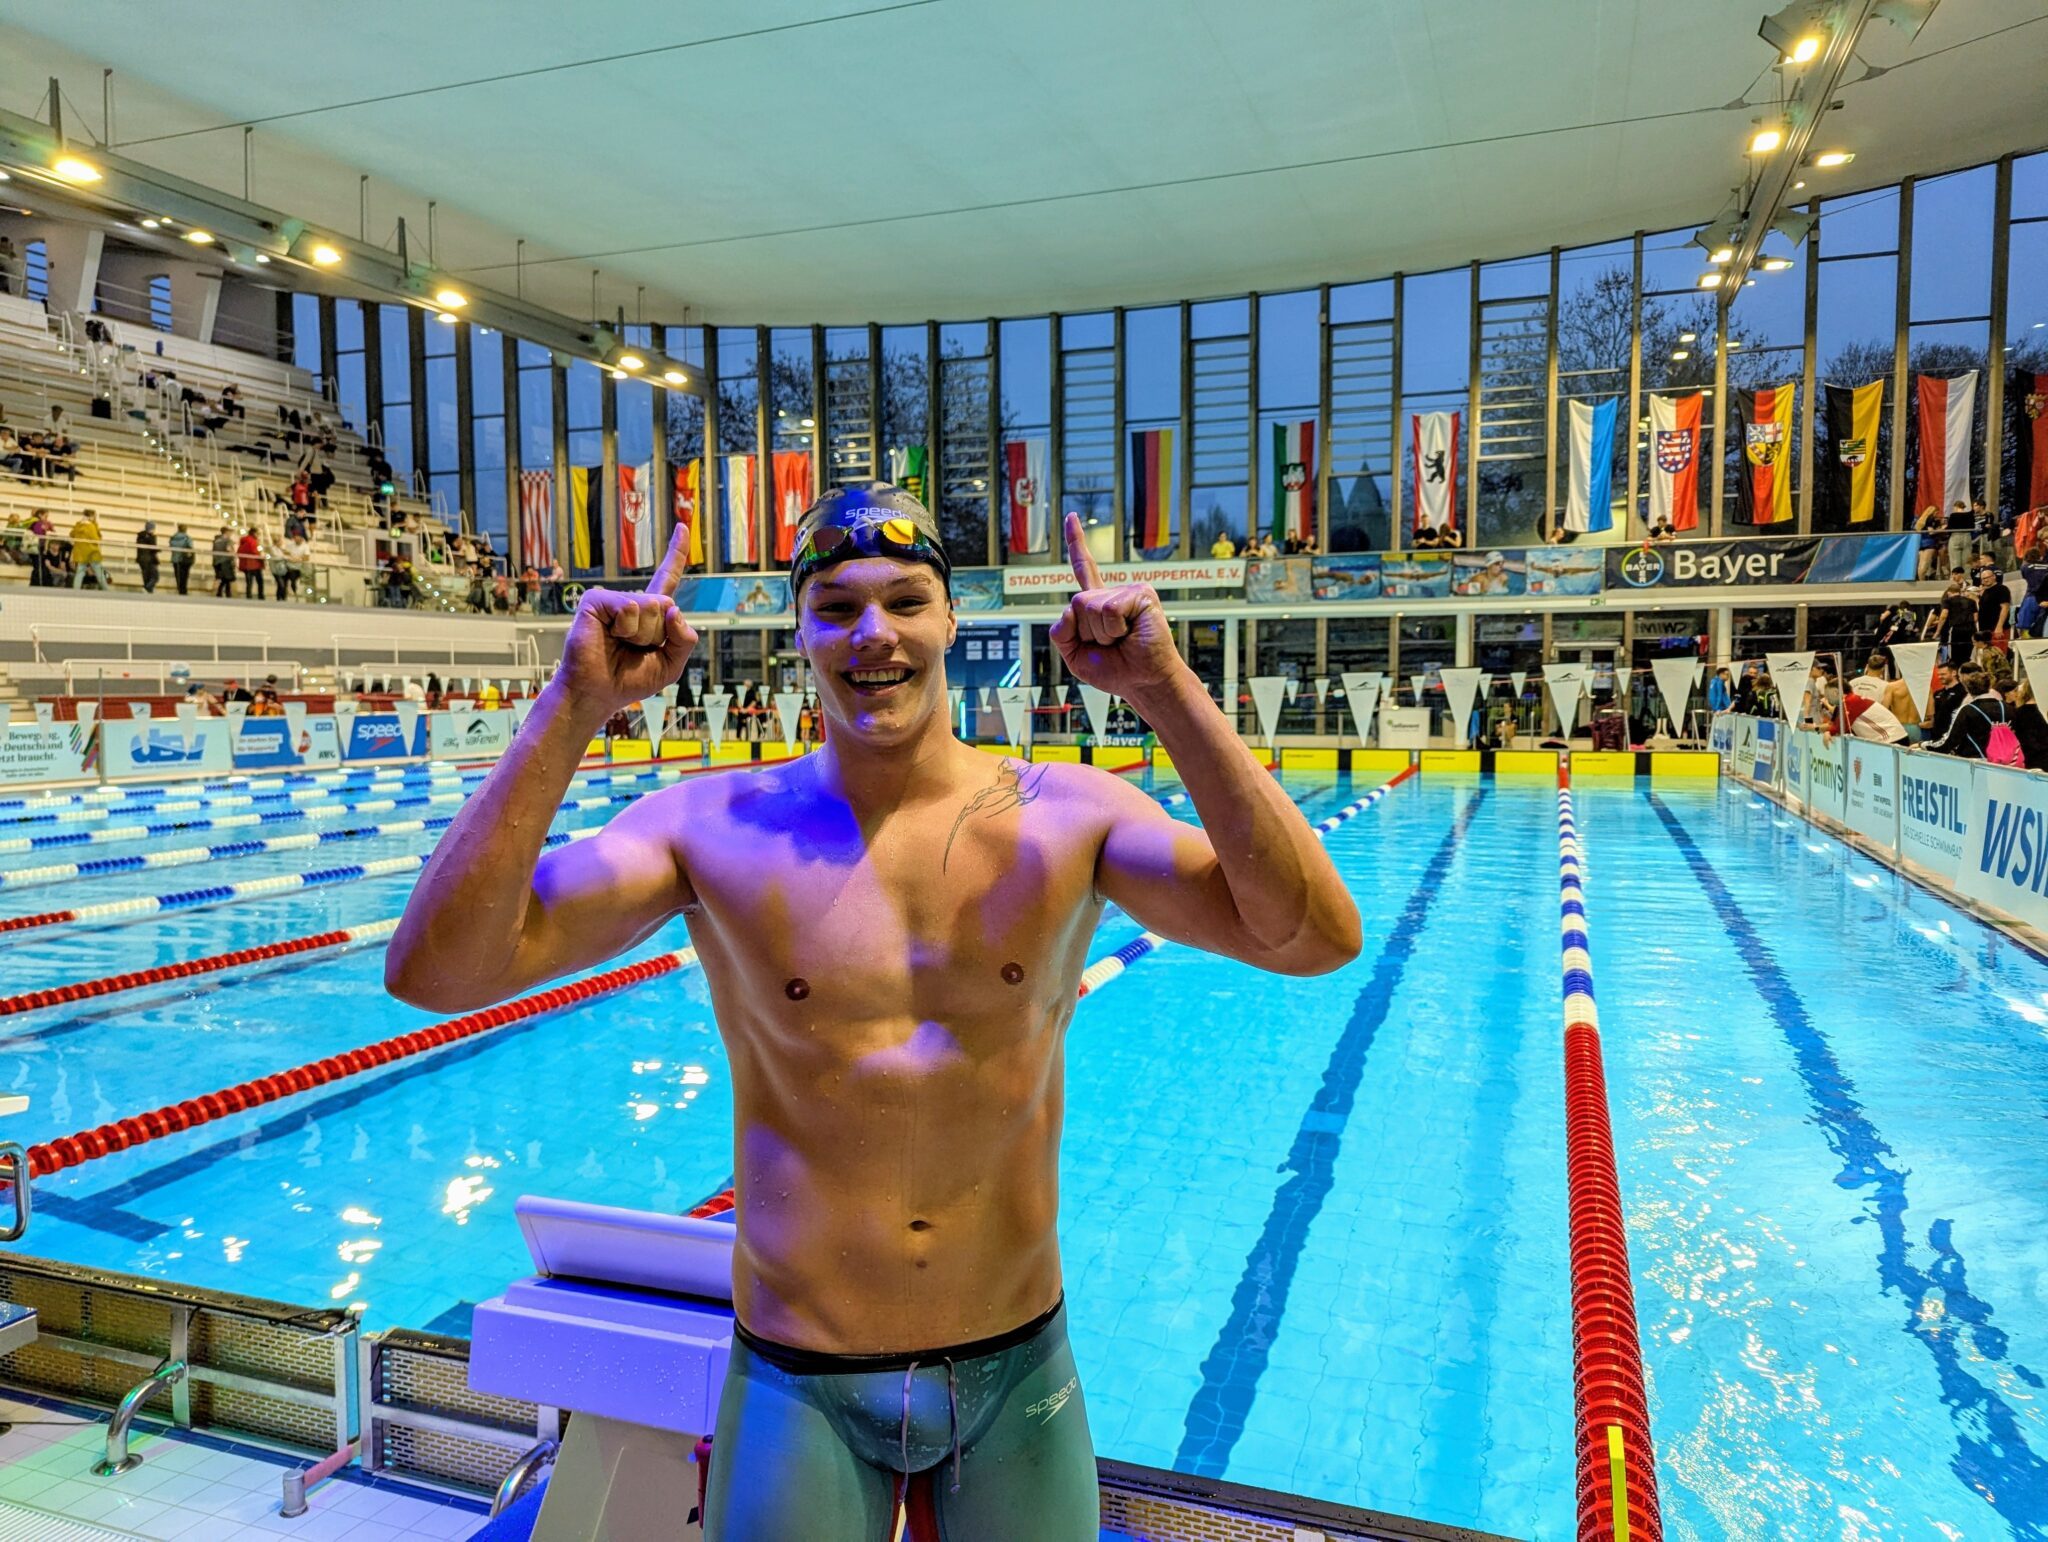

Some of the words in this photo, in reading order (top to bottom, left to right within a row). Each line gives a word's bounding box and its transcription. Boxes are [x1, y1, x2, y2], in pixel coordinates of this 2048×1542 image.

[1131, 568, 1211, 582] WUPPERTAL
[1216, 567, 1240, 579] E.V.
[1625, 562, 1660, 572] BAYER
[1674, 550, 1785, 584] Bayer
[357, 723, 402, 740] speed
[1026, 1376, 1076, 1418] speedo
